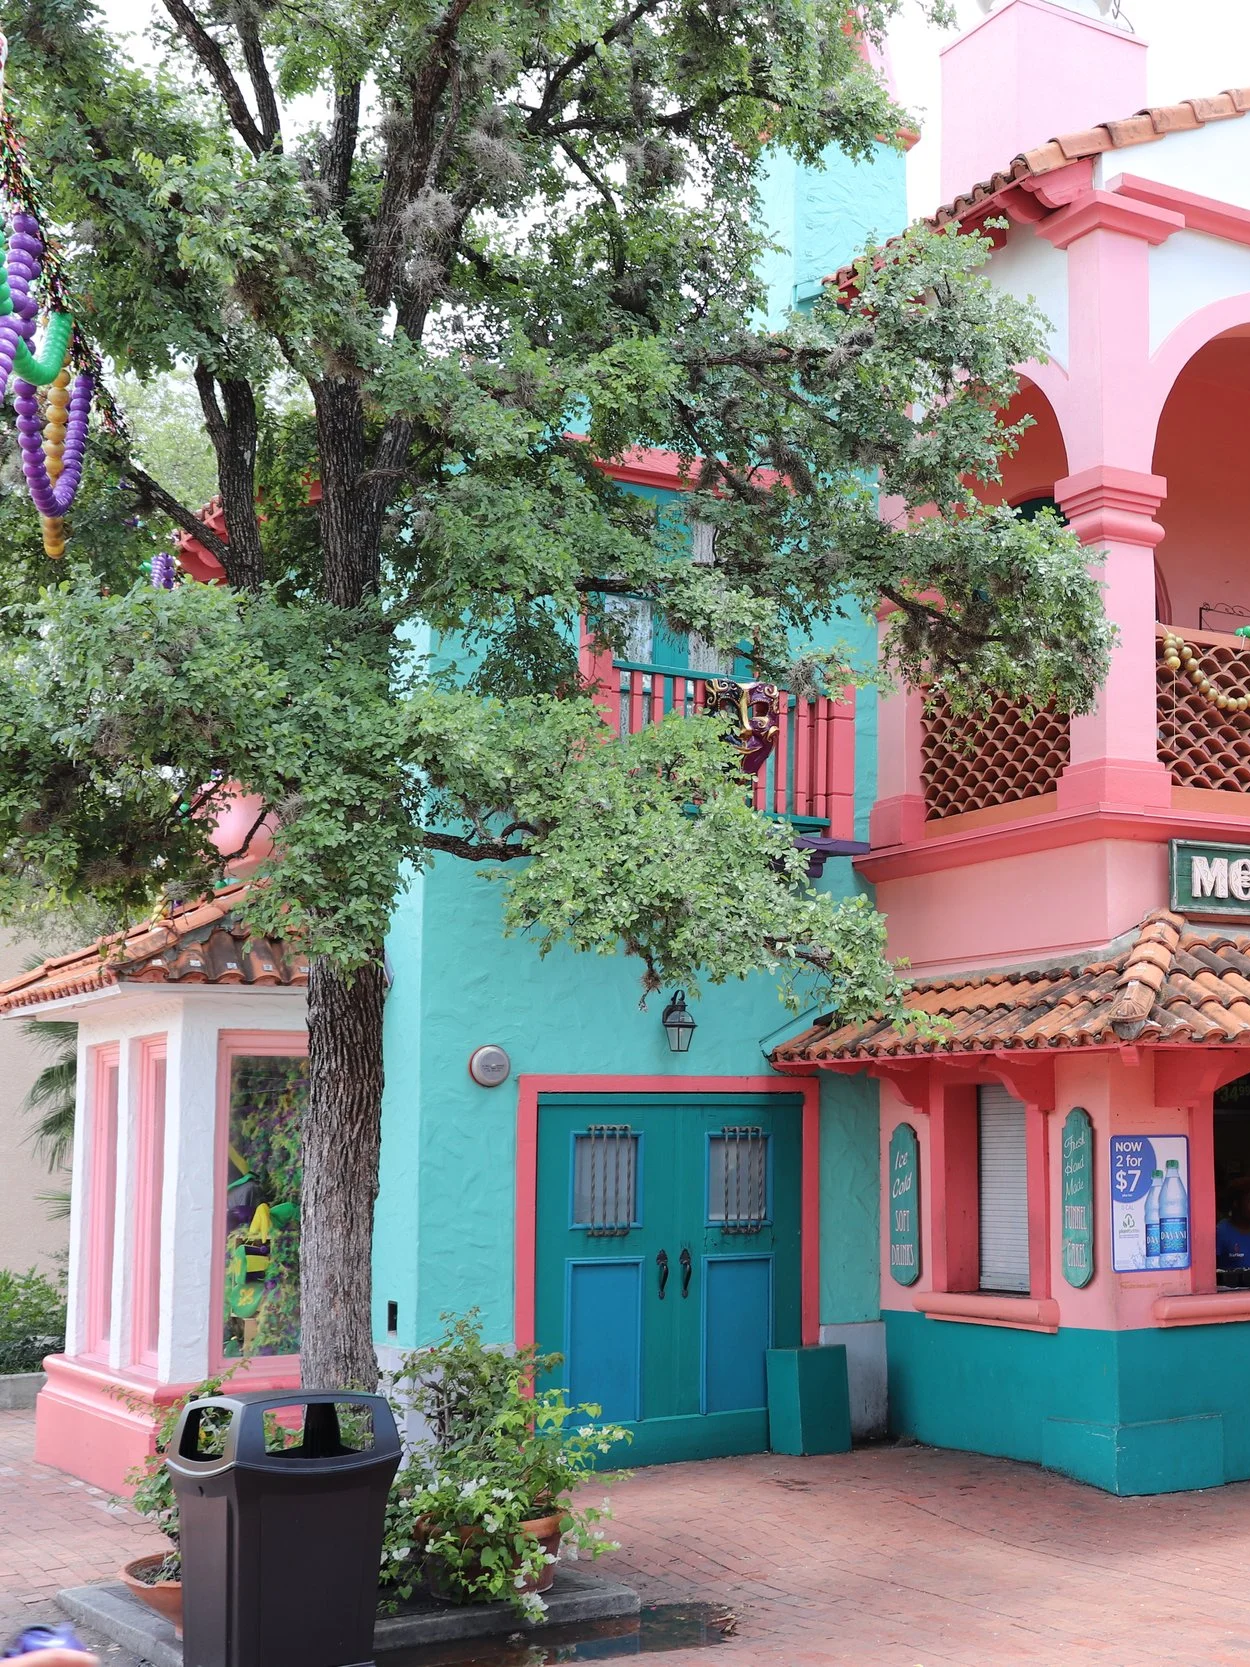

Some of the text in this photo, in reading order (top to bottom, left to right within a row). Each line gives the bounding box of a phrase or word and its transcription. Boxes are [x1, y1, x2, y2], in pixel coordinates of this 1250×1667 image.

[1063, 1130, 1086, 1159] Fresh
[1115, 1141, 1143, 1152] NOW
[894, 1151, 908, 1170] Ice
[1064, 1157, 1085, 1177] Hand
[1116, 1155, 1142, 1167] 2 for
[892, 1172, 912, 1199] Cold
[1065, 1179, 1085, 1201] Made
[1115, 1169, 1142, 1193] $7
[895, 1210, 910, 1232] SOFT
[1064, 1205, 1087, 1230] FUNNEL
[891, 1244, 914, 1266] DRINKS
